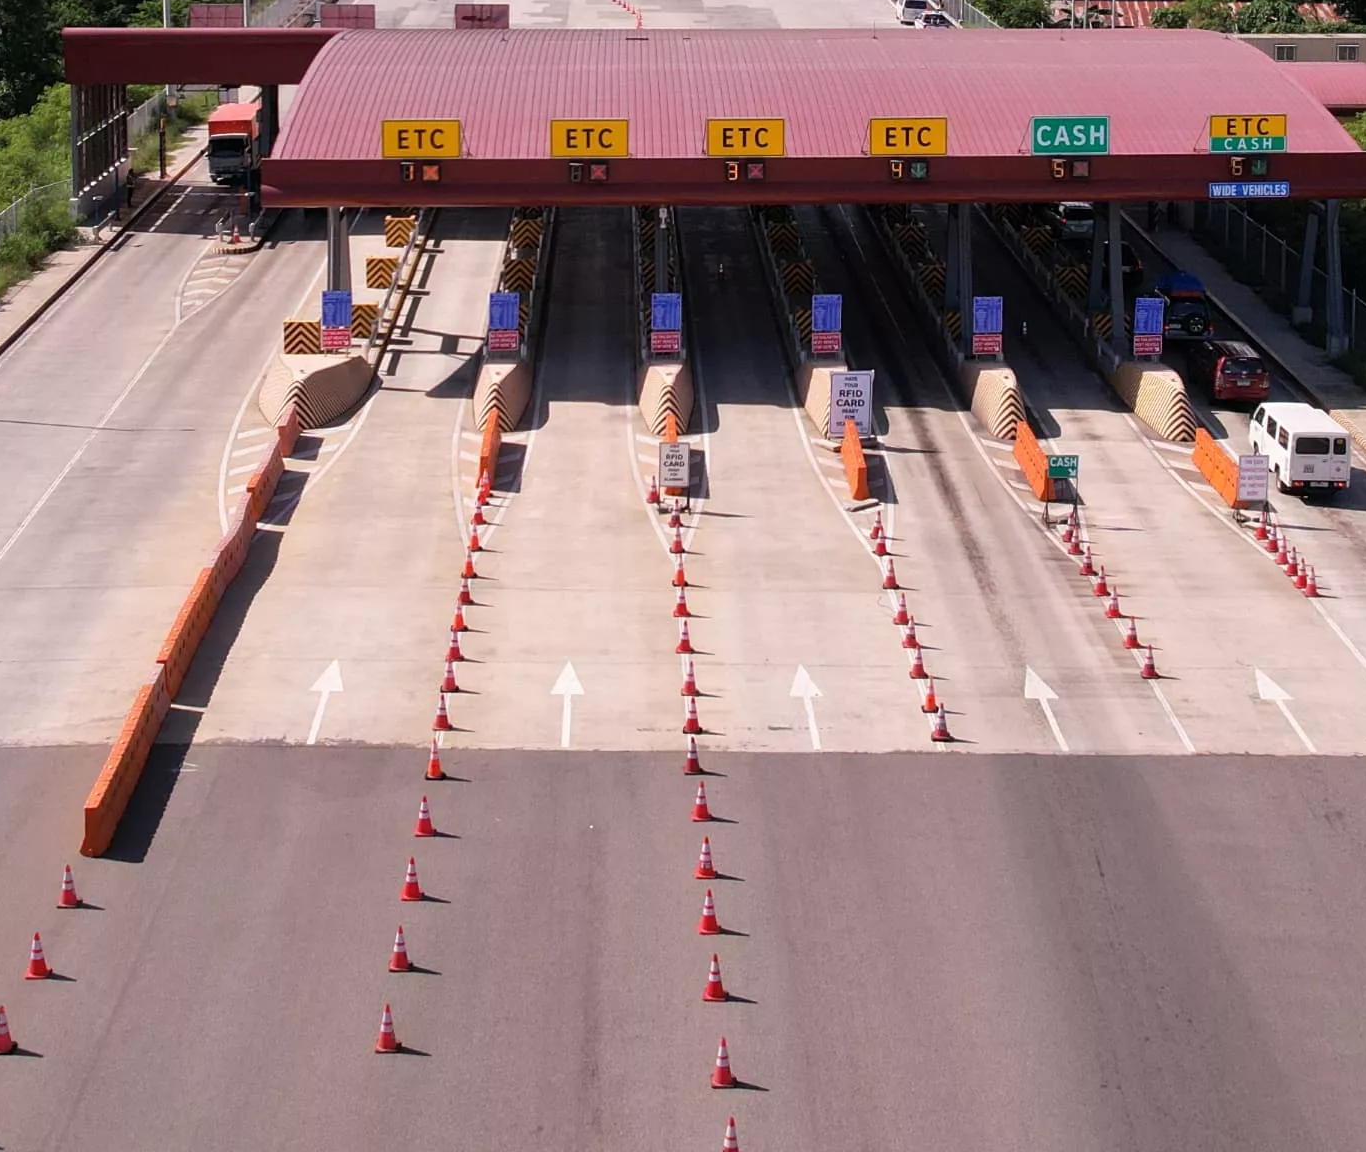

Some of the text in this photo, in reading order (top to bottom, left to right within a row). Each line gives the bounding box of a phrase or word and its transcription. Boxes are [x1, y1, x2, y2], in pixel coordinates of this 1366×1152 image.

[1226, 118, 1269, 136] ETC
[398, 129, 444, 149] ETC
[566, 128, 613, 148] ETC
[722, 128, 769, 148] ETC
[885, 127, 932, 147] ETC
[1036, 125, 1105, 147] CASH
[1224, 138, 1272, 150] CASH
[728, 163, 738, 181] 3
[891, 163, 902, 179] 4
[1054, 161, 1064, 178] 5
[1212, 184, 1287, 196] WIDE VEHICLES
[839, 389, 863, 398] RFID
[836, 399, 865, 407] CARD
[663, 460, 685, 468] CARD
[1050, 457, 1077, 467] CASH
